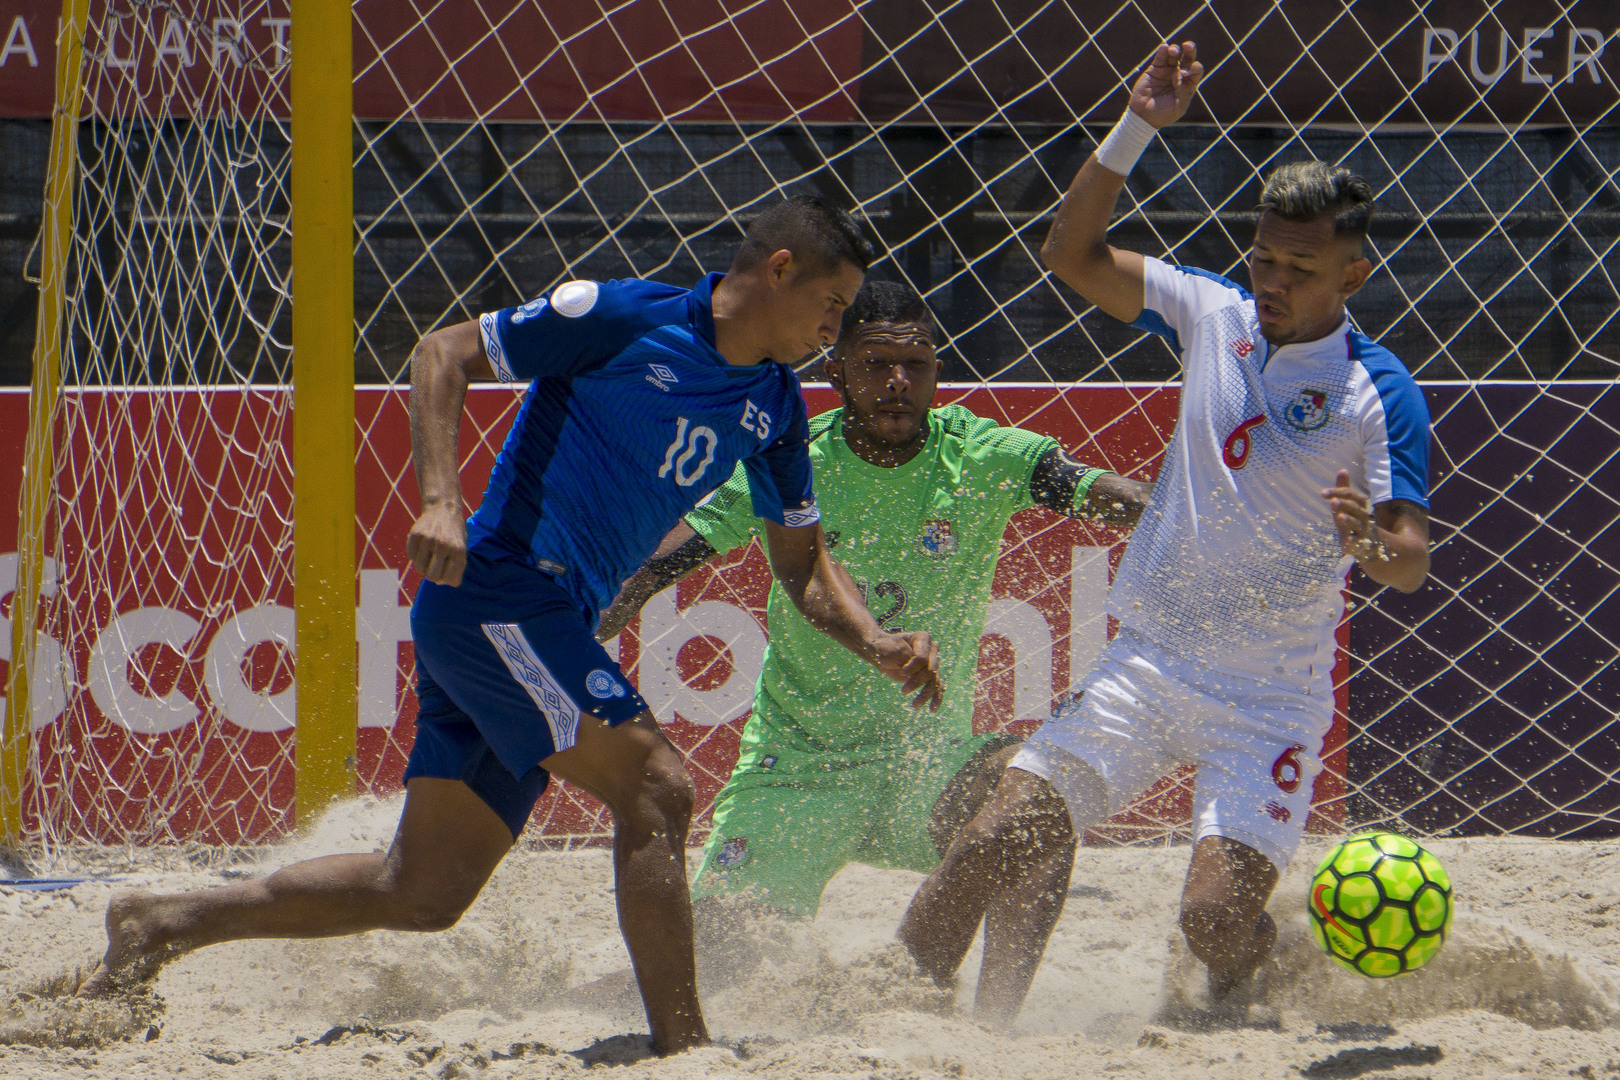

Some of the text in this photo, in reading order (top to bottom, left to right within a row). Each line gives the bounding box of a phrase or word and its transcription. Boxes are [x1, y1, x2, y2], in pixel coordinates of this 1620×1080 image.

[1421, 27, 1620, 86] PUER
[645, 374, 670, 392] umbro
[740, 398, 772, 440] ES
[1222, 412, 1267, 470] 6
[658, 416, 718, 487] 10
[1271, 743, 1308, 795] 6
